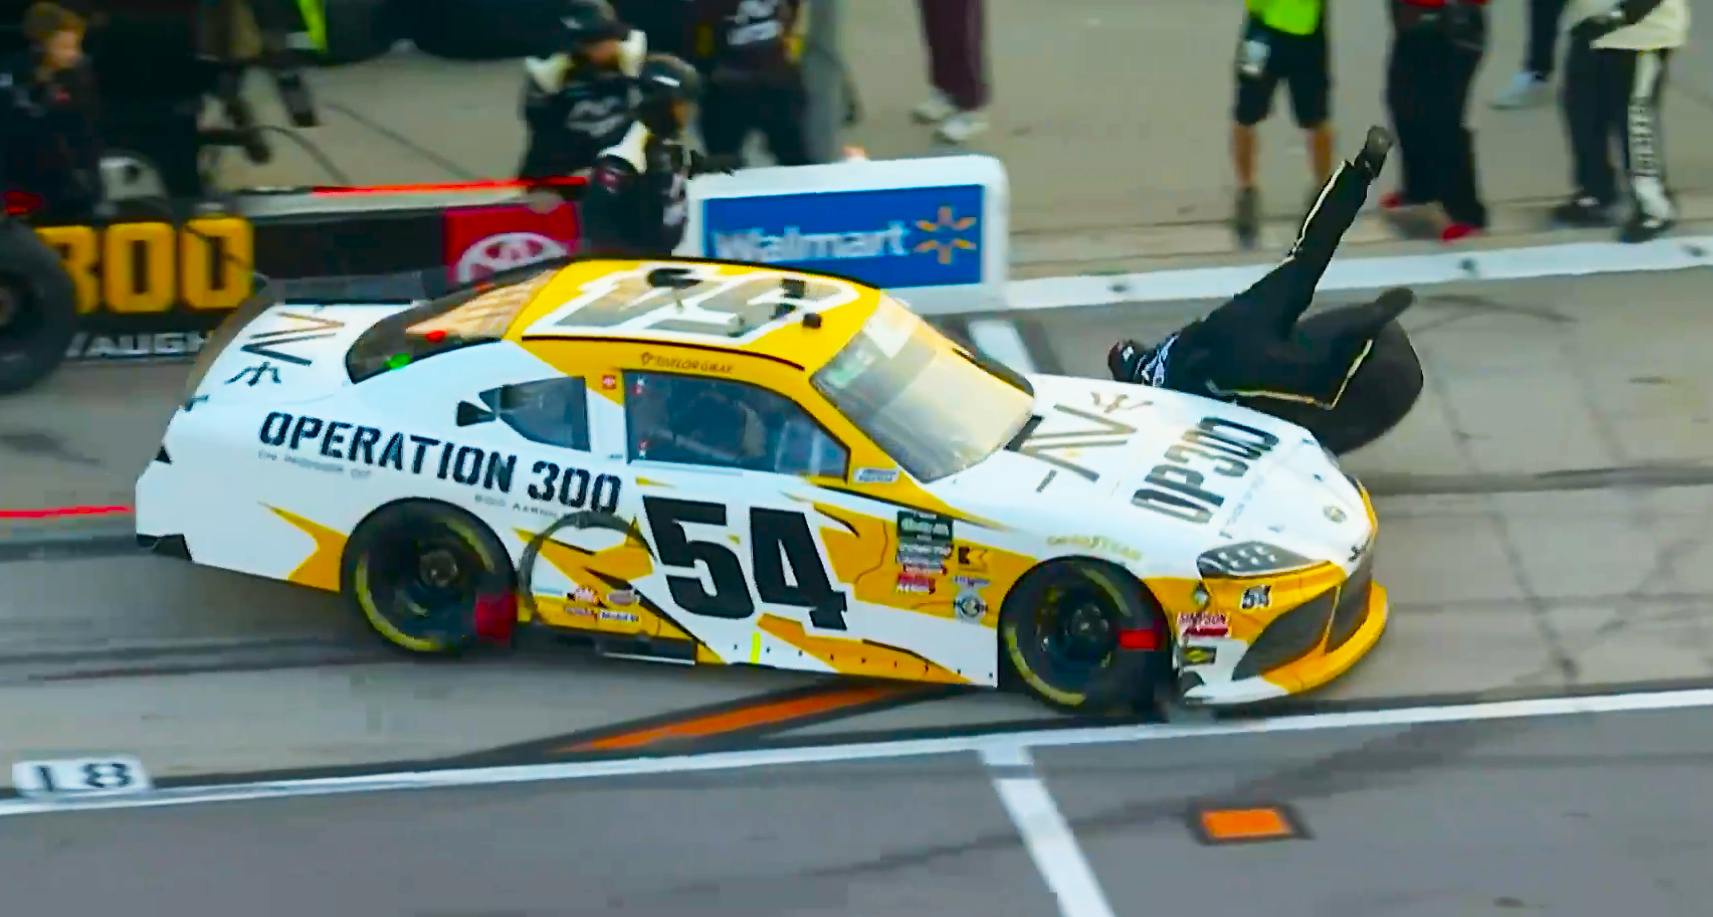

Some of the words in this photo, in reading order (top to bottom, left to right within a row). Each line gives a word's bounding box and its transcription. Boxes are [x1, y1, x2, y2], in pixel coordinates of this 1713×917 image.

[711, 221, 908, 262] Walmart
[259, 411, 516, 493] OPERATION
[527, 460, 622, 513] 300
[1130, 416, 1279, 523] OP300
[641, 496, 848, 631] 54
[34, 762, 133, 793] 18
